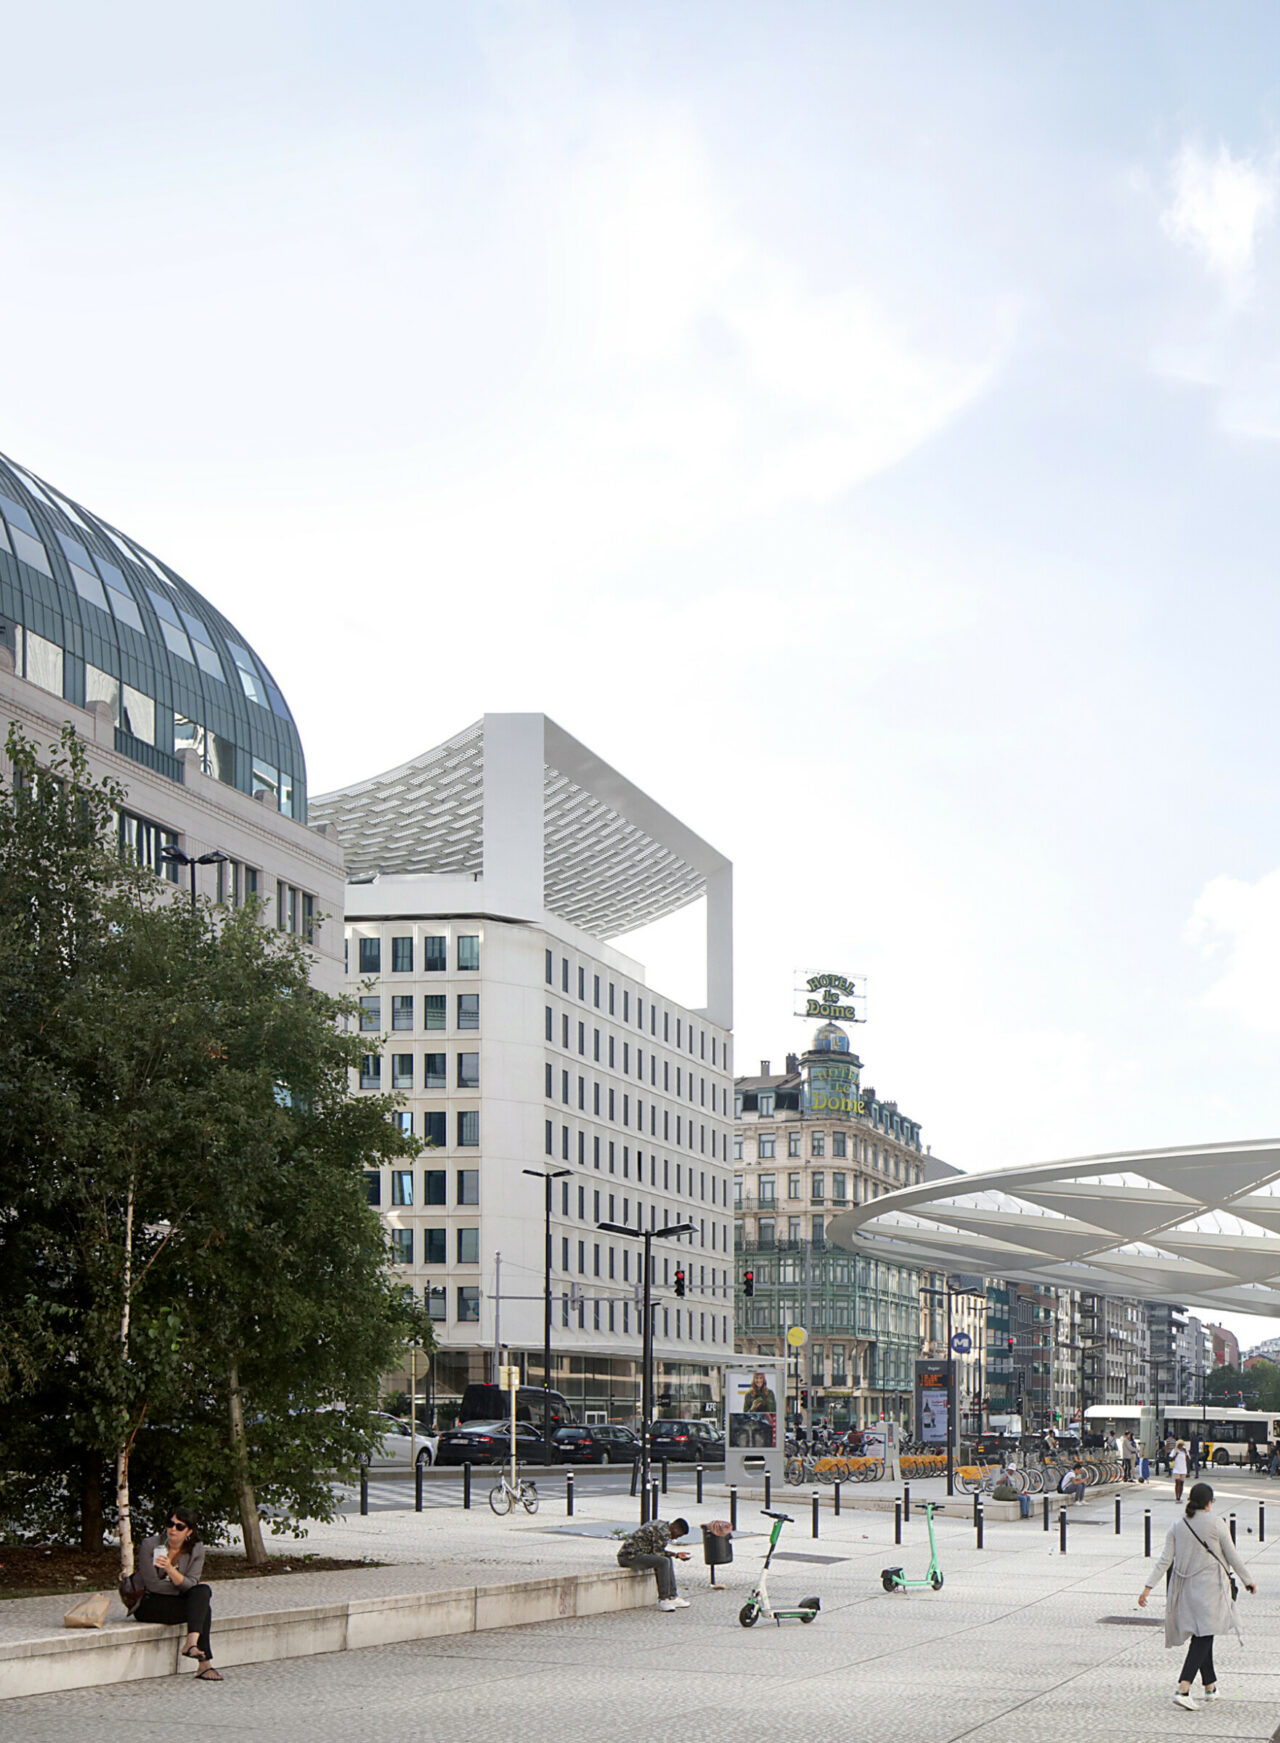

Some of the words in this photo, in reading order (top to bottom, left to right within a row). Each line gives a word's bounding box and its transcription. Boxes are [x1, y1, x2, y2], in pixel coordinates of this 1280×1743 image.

[806, 974, 856, 996] HOTEL
[823, 989, 840, 1004] Le
[806, 999, 856, 1019] Dome
[812, 1091, 865, 1114] Dome
